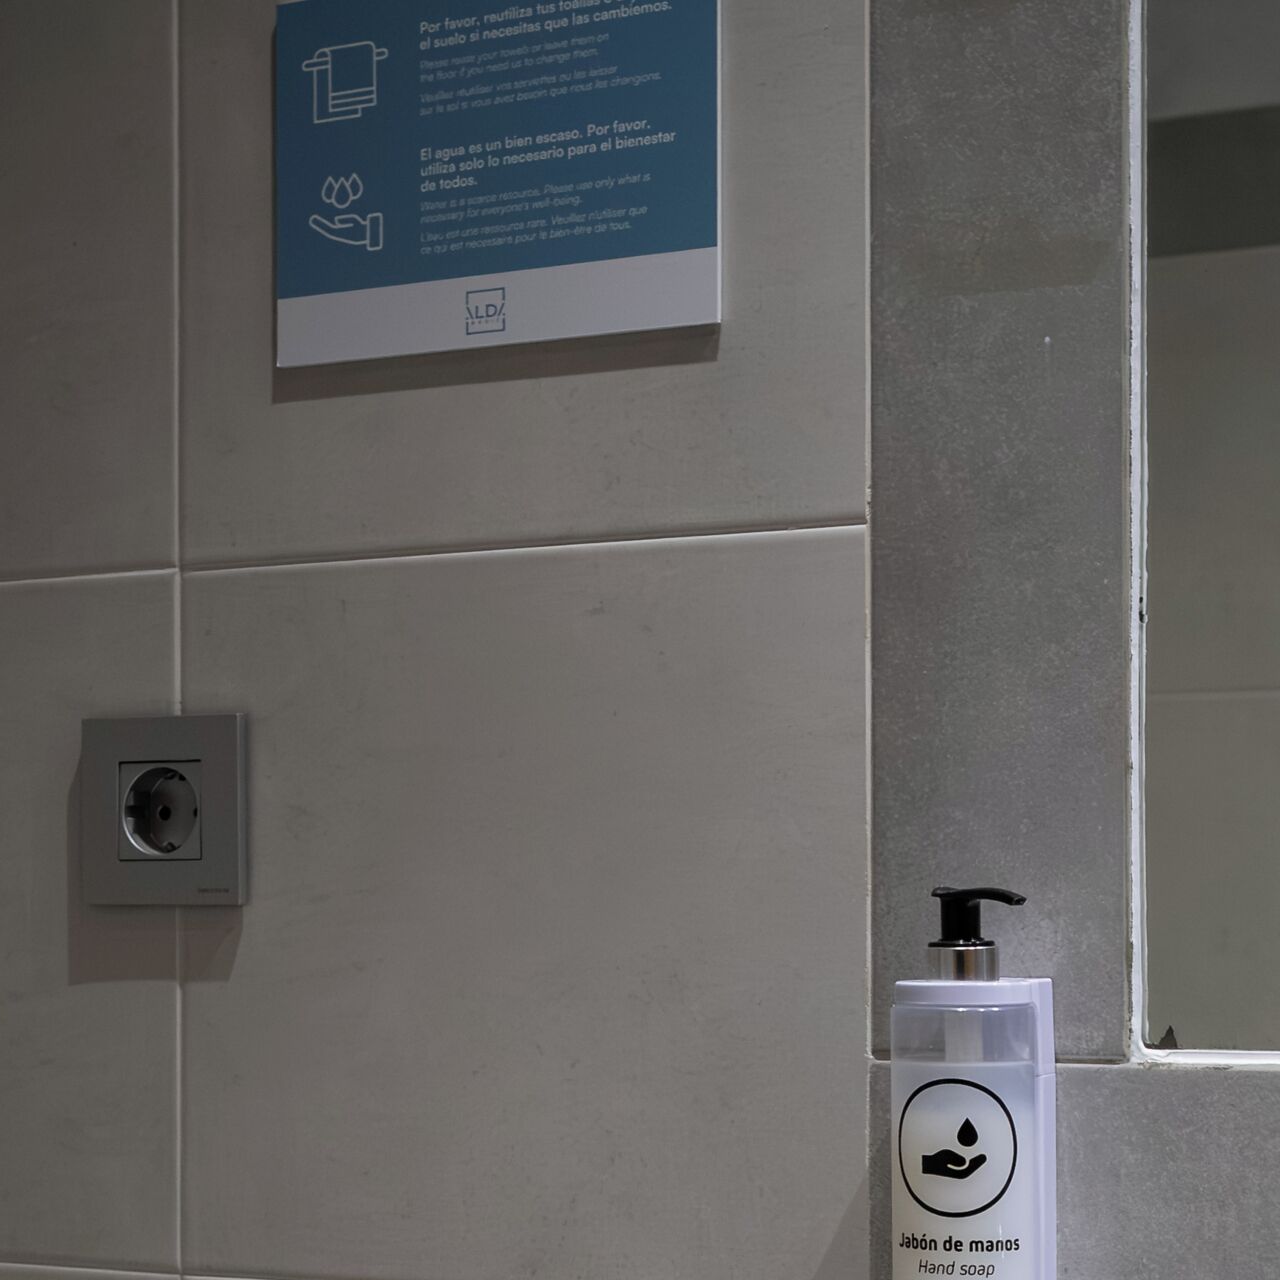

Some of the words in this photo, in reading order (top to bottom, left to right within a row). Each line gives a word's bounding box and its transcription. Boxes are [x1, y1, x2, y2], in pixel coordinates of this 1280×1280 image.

[419, 37, 431, 50] el
[433, 33, 466, 48] suelo
[469, 30, 480, 42] si
[482, 22, 541, 39] necesitas
[543, 18, 569, 31] que
[571, 13, 590, 25] las
[420, 22, 441, 33] Por
[483, 7, 533, 22] reutiliza
[536, 4, 557, 14] tus
[420, 148, 432, 160] El
[434, 147, 466, 161] agua
[468, 144, 483, 153] es
[485, 141, 502, 151] un
[504, 136, 533, 148] bien
[535, 130, 583, 144] escaso.
[586, 124, 610, 136] Por
[420, 162, 457, 176] utiliza
[458, 157, 485, 171] solo
[487, 155, 500, 166] lo
[502, 146, 565, 164] necesario
[567, 144, 597, 159] para
[600, 138, 612, 151] el
[615, 132, 677, 149] bienestar
[420, 181, 437, 192] de
[439, 176, 478, 189] todos.
[899, 1232, 938, 1251] Jabón
[943, 1235, 963, 1252] de
[969, 1238, 1020, 1252] manos
[918, 1259, 956, 1275] Hand
[959, 1264, 995, 1278] soap
